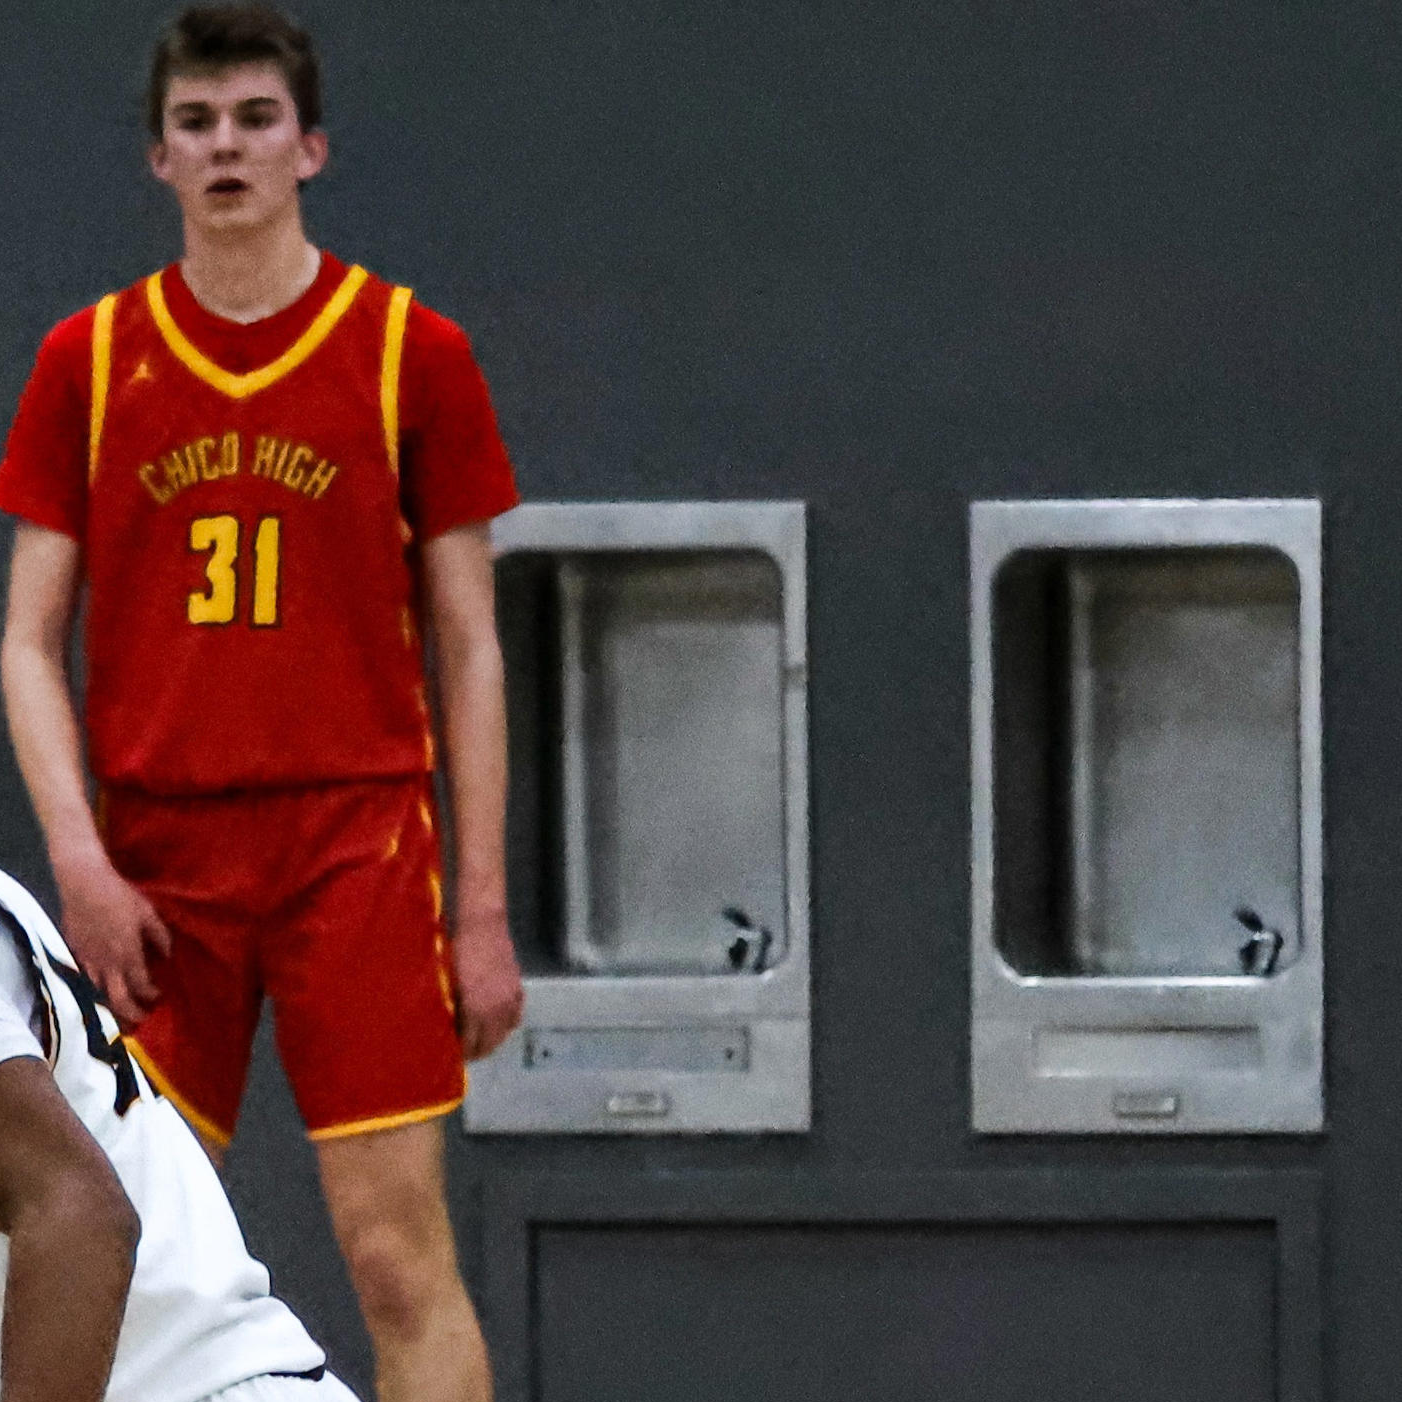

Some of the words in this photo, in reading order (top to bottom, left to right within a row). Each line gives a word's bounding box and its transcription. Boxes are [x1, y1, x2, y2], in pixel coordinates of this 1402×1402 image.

[138, 431, 240, 503] CHICO
[252, 436, 338, 500] HIGH
[186, 512, 282, 630] 31
